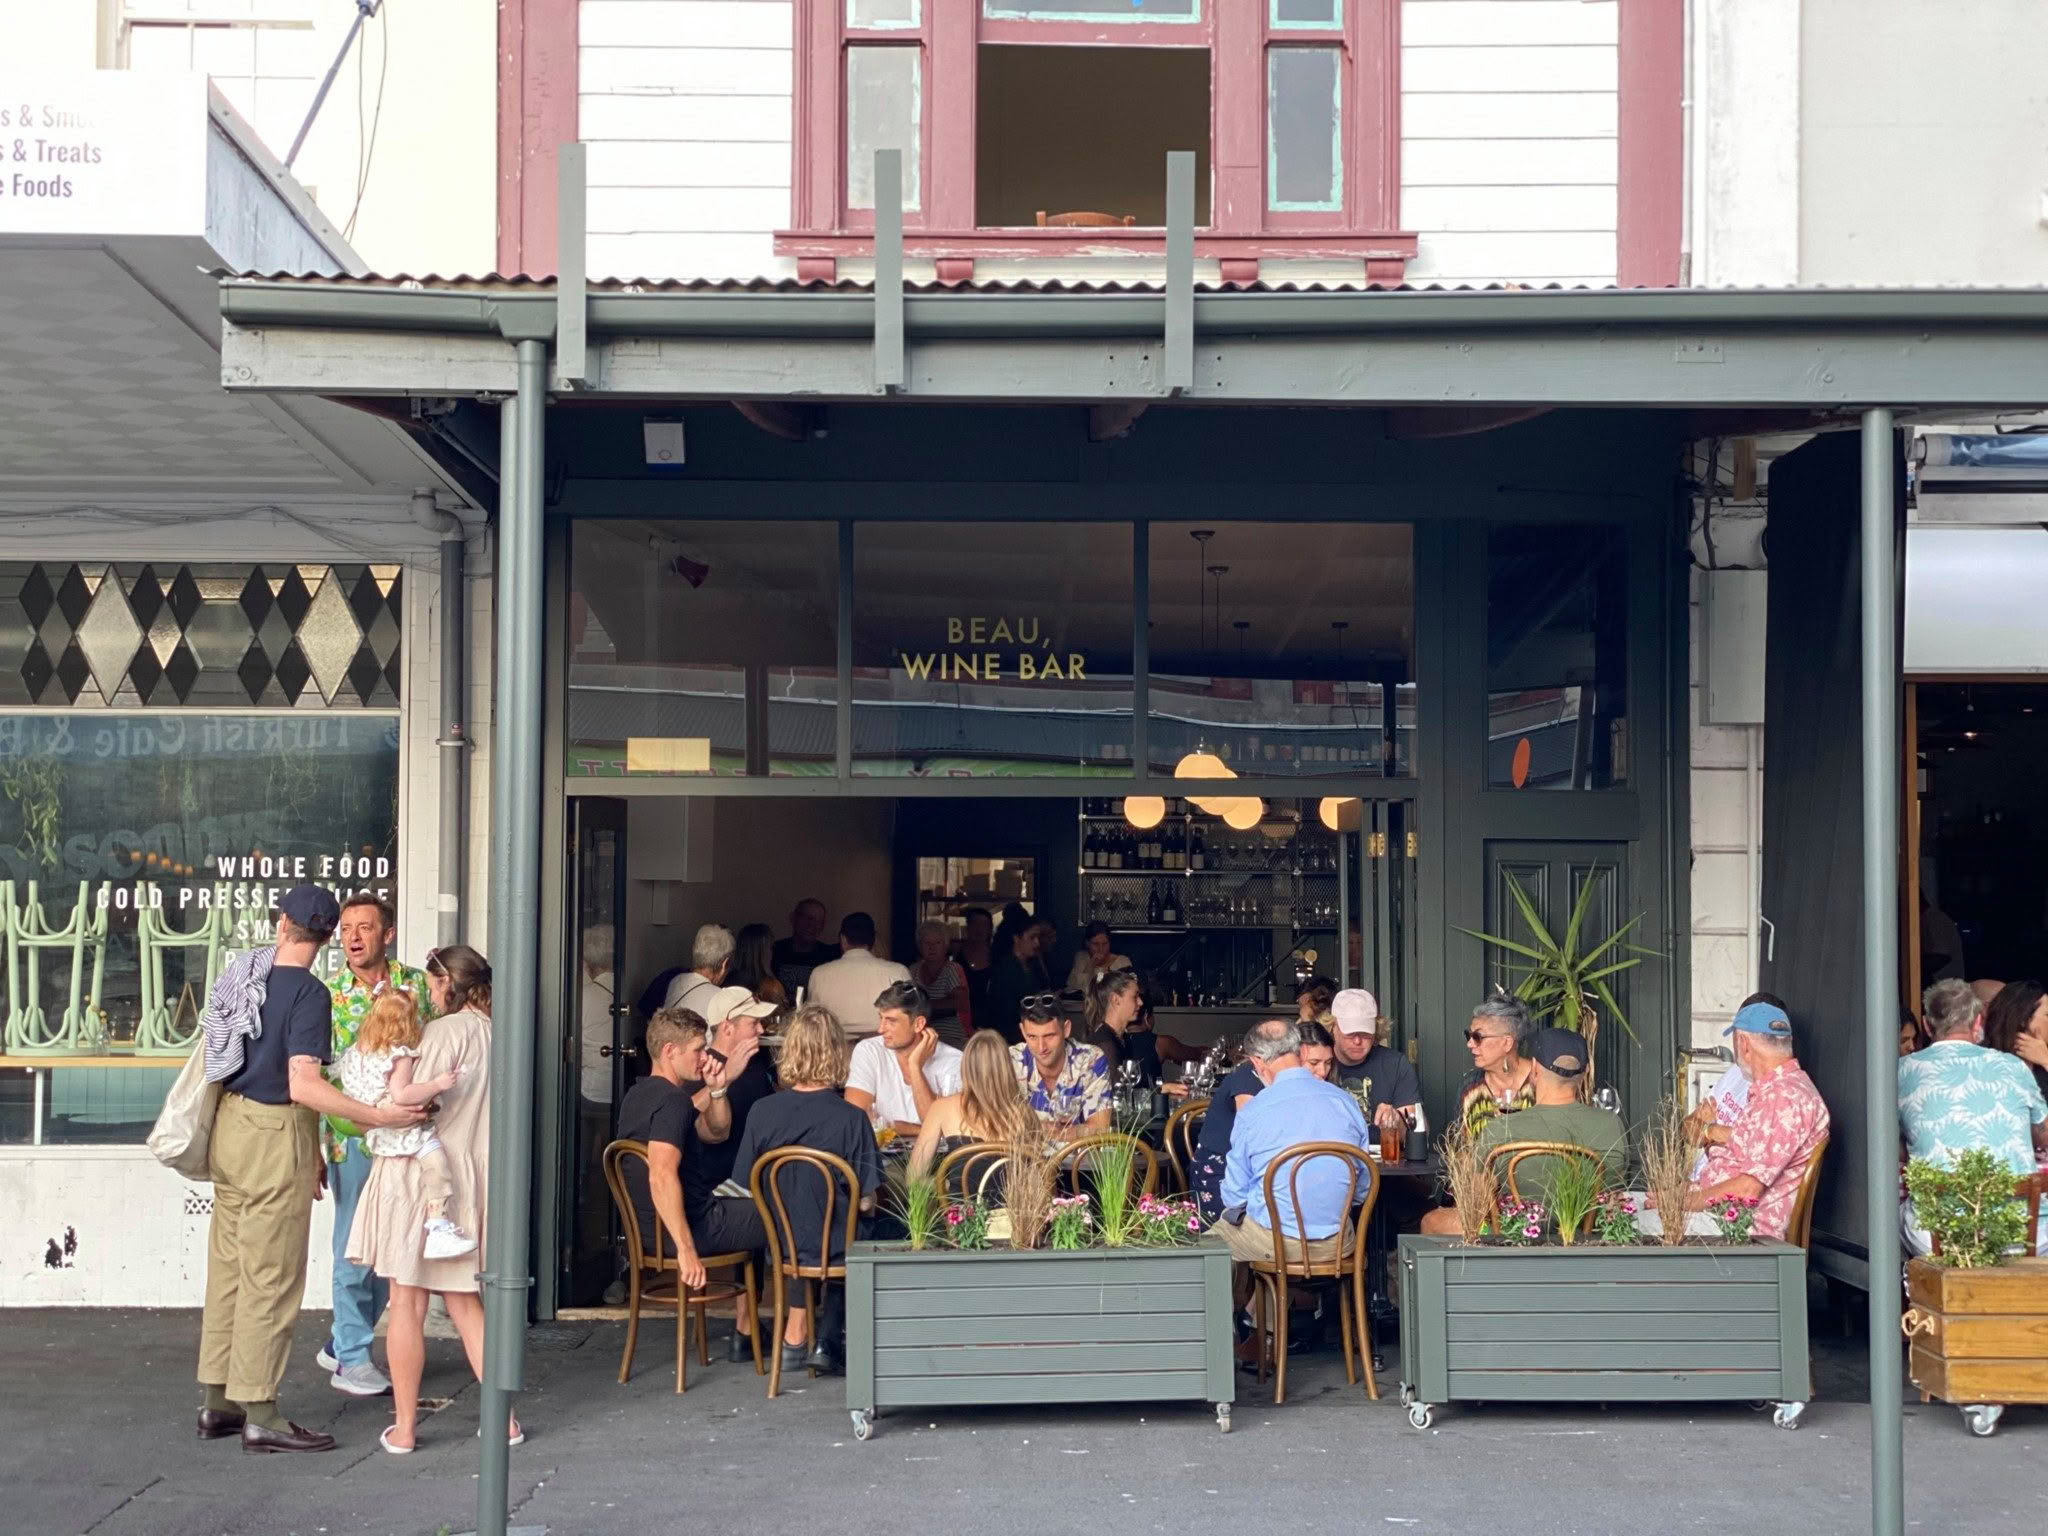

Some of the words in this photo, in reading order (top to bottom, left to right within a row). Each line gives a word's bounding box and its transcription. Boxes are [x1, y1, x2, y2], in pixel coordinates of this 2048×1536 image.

[19, 104, 33, 127] &
[12, 138, 27, 162] &
[34, 138, 102, 163] Treats
[12, 173, 73, 198] Foods
[948, 617, 1050, 649] BEAU,
[901, 652, 1000, 681] WINE
[1019, 652, 1087, 681] BAR
[217, 856, 306, 878] WHOLE
[322, 856, 389, 878] FOOD
[97, 887, 162, 910] COLD
[179, 887, 293, 910] PRESSE
